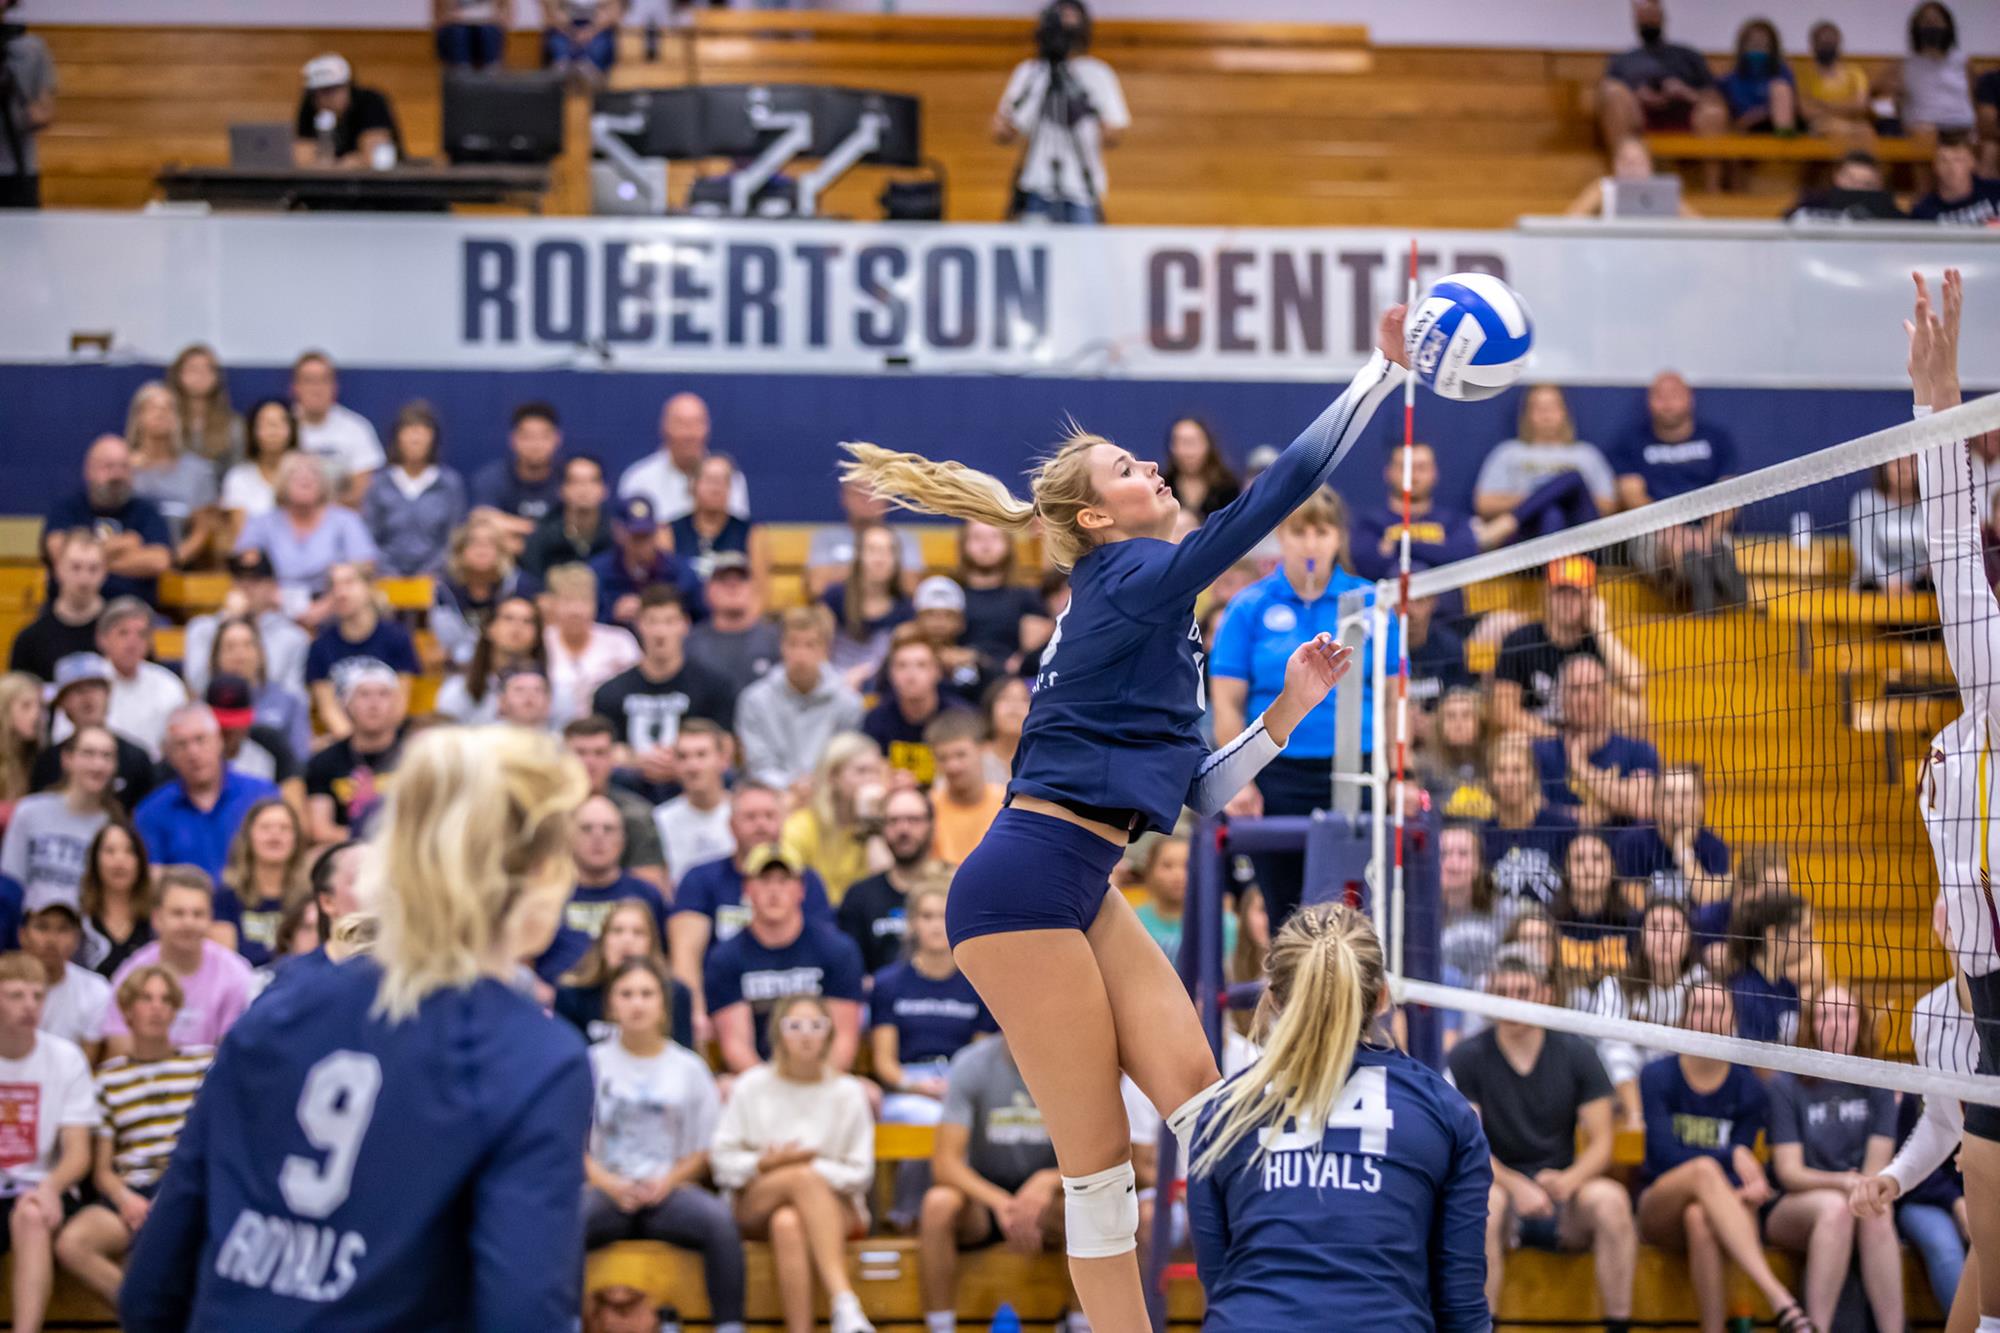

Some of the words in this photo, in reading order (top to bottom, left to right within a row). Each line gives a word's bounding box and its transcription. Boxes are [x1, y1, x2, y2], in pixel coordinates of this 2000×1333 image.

[463, 238, 1050, 349] ROBERTSON
[1149, 248, 1510, 353] CENT
[277, 1049, 384, 1219] 9
[1263, 1150, 1383, 1194] ROYALS
[215, 1208, 368, 1302] ROYALS
